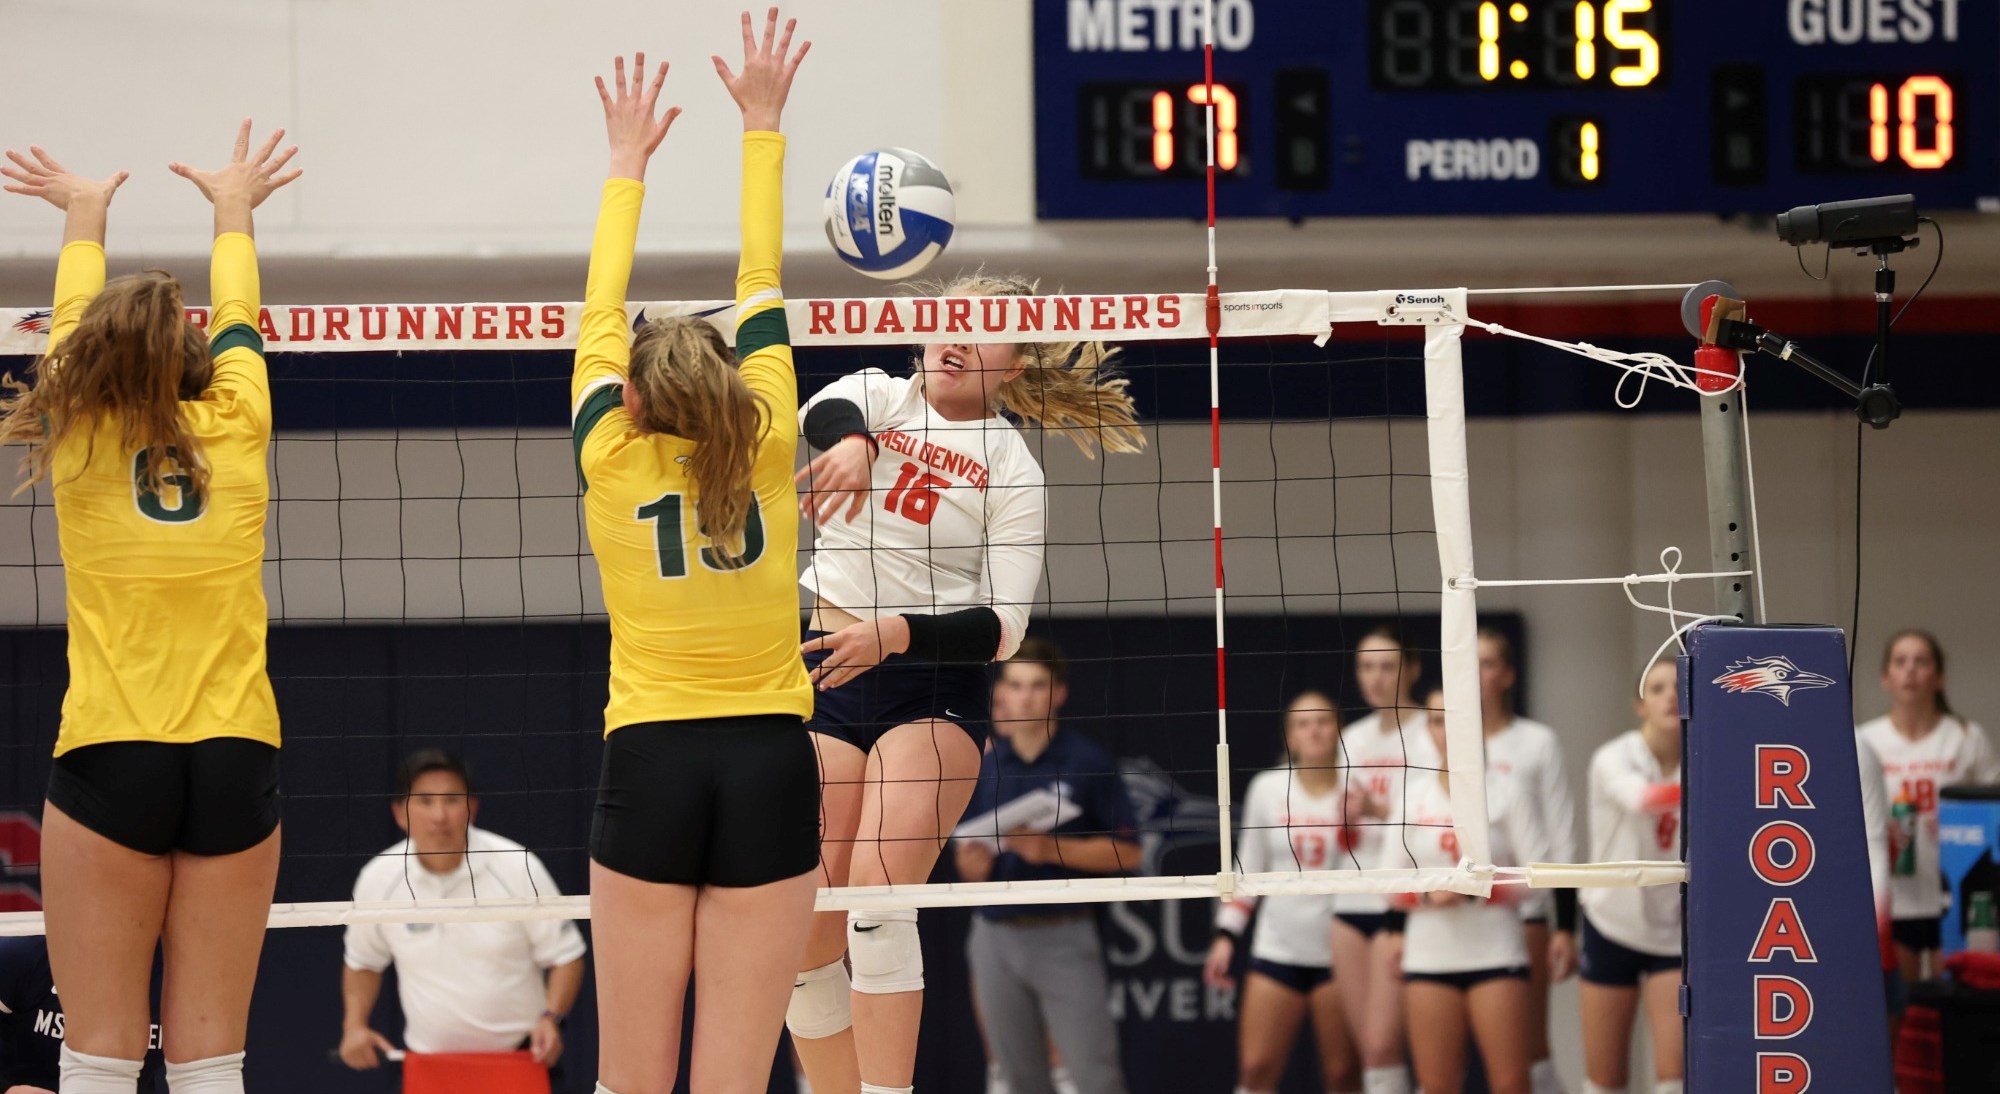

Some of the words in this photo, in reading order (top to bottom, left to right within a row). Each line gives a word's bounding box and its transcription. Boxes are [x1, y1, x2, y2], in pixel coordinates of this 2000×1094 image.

[1067, 0, 1254, 51] METRO
[1479, 0, 1659, 86] 1:15
[1787, 0, 1958, 45] GUEST
[1153, 84, 1238, 171] 17
[1580, 122, 1598, 180] 1
[1870, 75, 1953, 169] 10
[1406, 138, 1540, 180] PERIOD
[878, 165, 896, 235] molten
[185, 304, 565, 342] RADRUNNERS
[809, 295, 1180, 335] ROADRUNNERS
[1407, 295, 1445, 304] Senoh
[131, 443, 209, 525] 6
[875, 430, 918, 457] MSU
[918, 441, 989, 494] DENVER
[883, 461, 953, 526] 16
